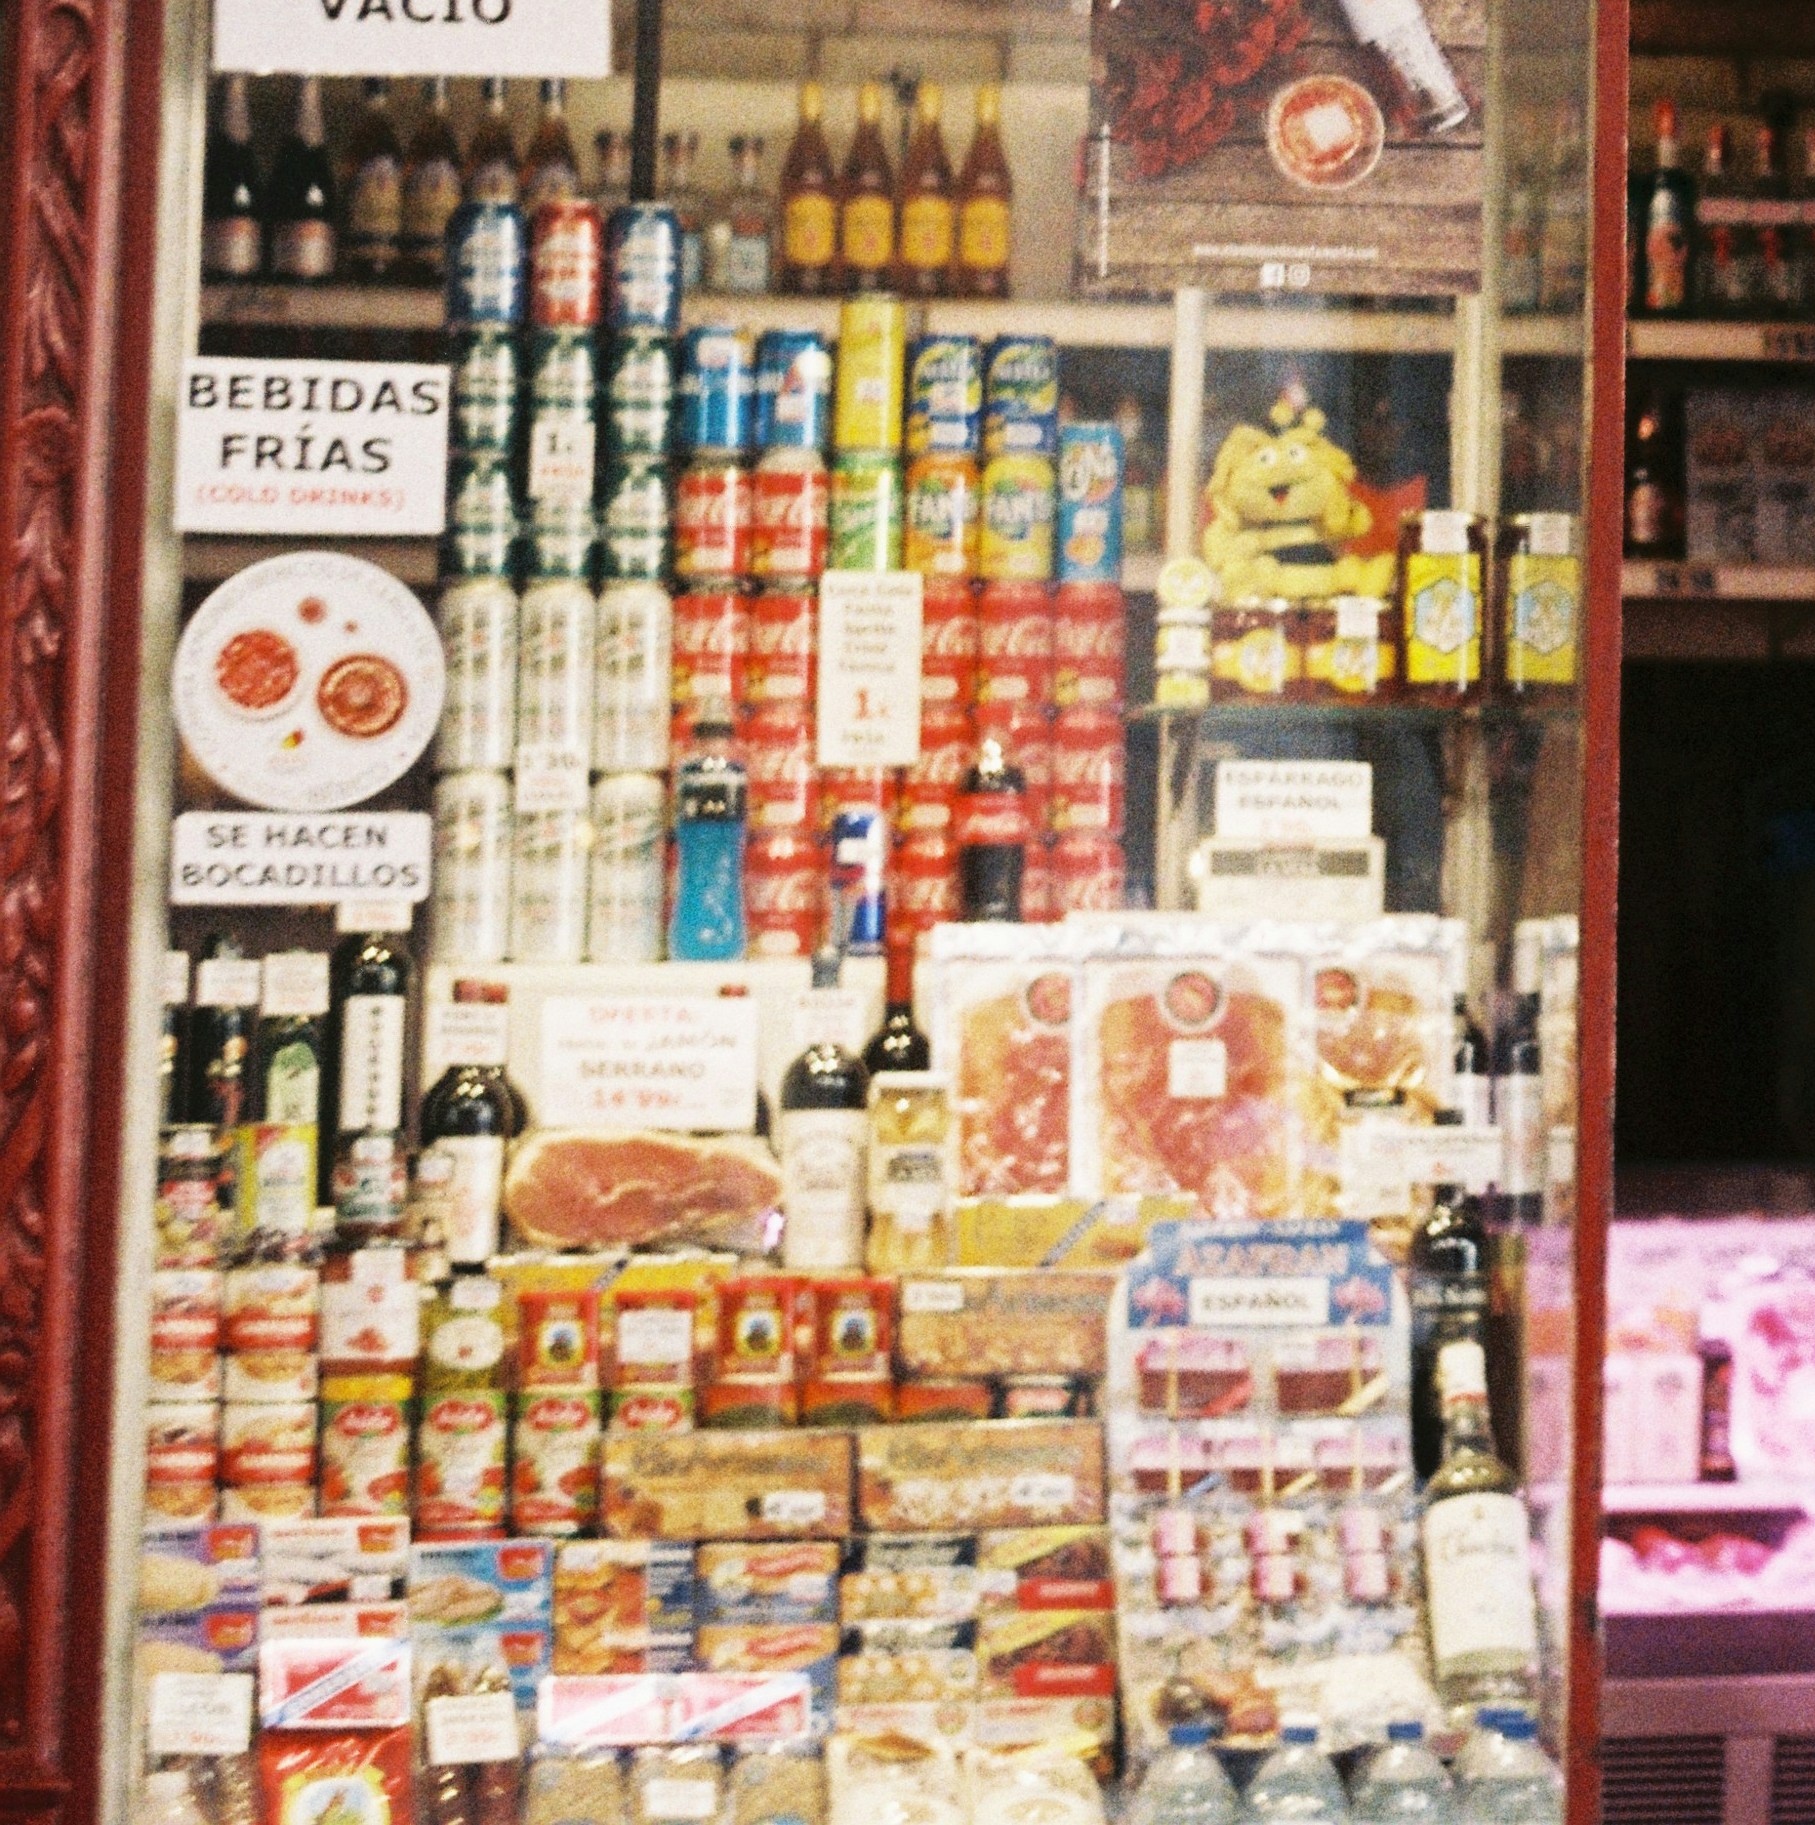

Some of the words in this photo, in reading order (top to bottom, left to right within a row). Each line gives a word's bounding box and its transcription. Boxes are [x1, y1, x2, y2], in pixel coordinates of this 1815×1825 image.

[188, 374, 441, 415] BEBIDAS
[220, 420, 393, 474] FRÍAS
[207, 825, 251, 850] SE
[265, 825, 387, 850] HACEN
[182, 863, 421, 888] BOCADILLOS
[1203, 1288, 1312, 1312] ESPAÑOL
